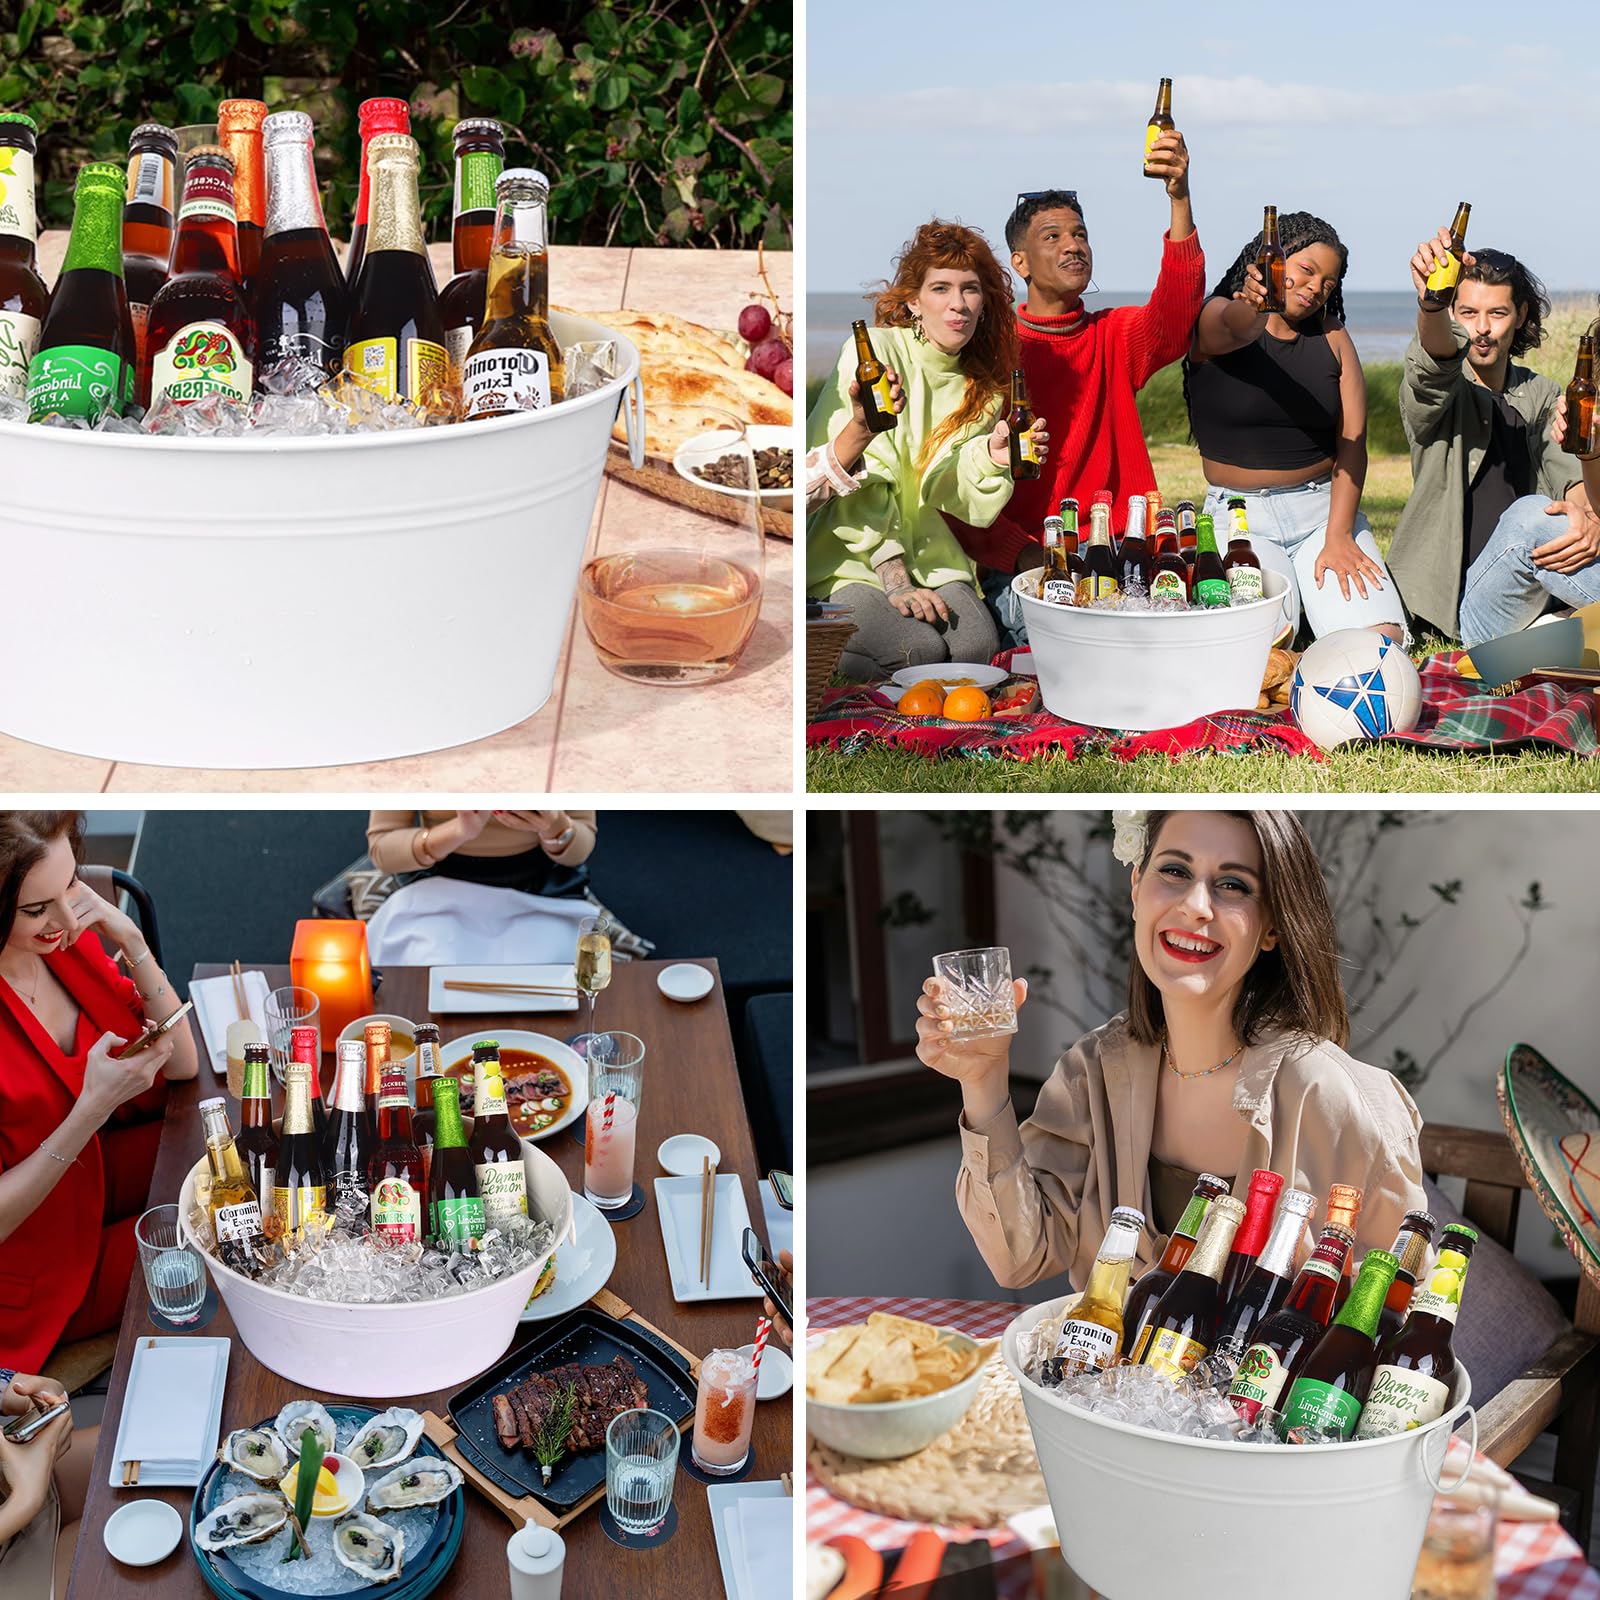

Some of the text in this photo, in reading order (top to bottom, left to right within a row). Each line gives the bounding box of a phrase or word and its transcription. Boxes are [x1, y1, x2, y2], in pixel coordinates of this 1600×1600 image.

[480, 1178, 522, 1195] Lemon
[485, 1167, 523, 1185] Damm
[232, 1218, 255, 1227] Extra
[1062, 1320, 1113, 1346] Coronita
[1070, 1335, 1097, 1350] Extra
[1373, 1370, 1429, 1403] Damm
[1365, 1384, 1419, 1414] Lemon
[1297, 1396, 1348, 1428] Lindemans
